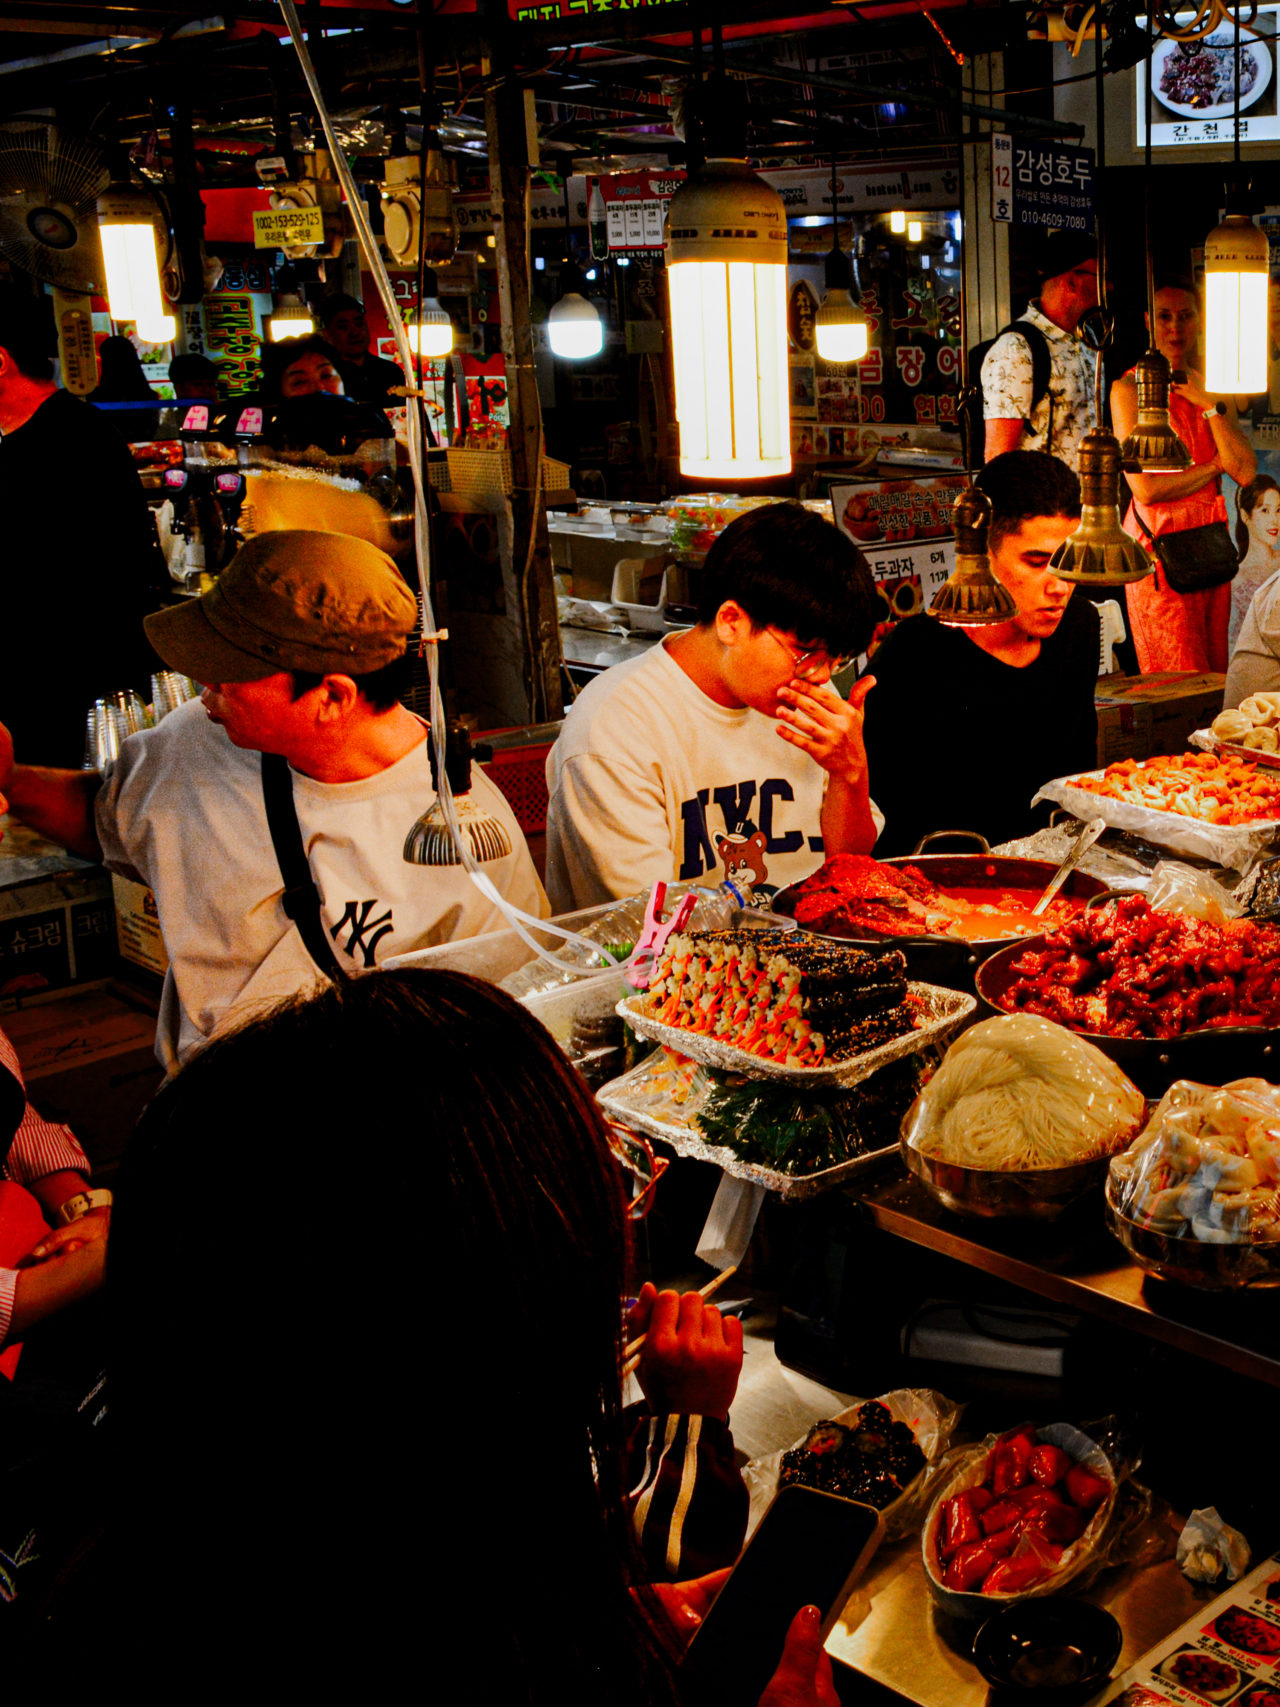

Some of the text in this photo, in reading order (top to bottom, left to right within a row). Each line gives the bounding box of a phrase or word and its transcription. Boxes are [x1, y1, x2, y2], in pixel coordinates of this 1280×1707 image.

[1173, 125, 1190, 137] 간
[996, 165, 1011, 188] 12
[1016, 149, 1093, 191] 감성호두
[996, 199, 1011, 220] 호
[1021, 209, 1087, 230] 010-4609-7080
[256, 212, 321, 230] 1002-153-529-125
[868, 492, 911, 511] 매일매일
[914, 491, 935, 508] 손수
[878, 513, 910, 532] 신선한
[912, 512, 937, 529] 식품,
[871, 550, 945, 580] 두과자 6개
[735, 822, 745, 834] U
[10, 920, 62, 956] 슈크림
